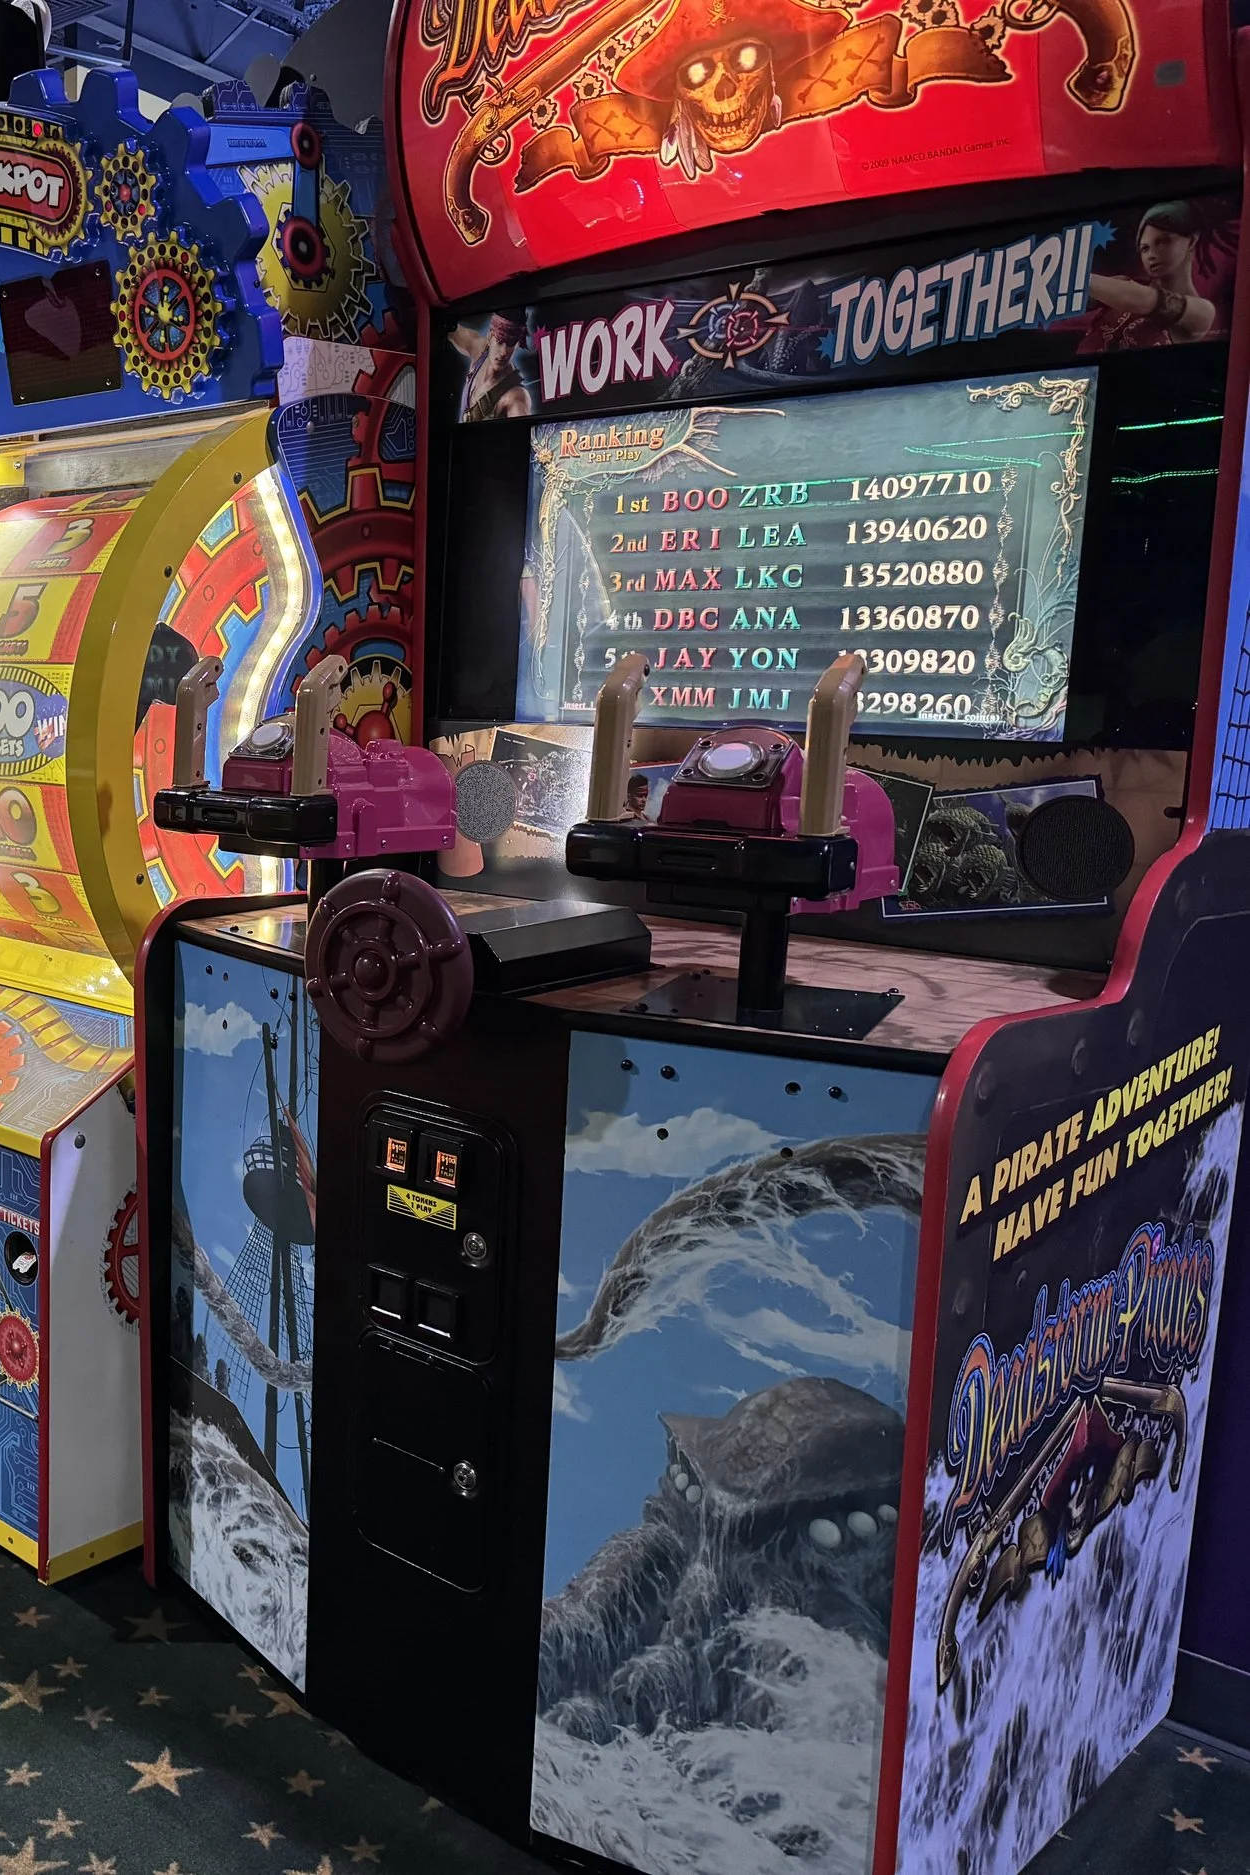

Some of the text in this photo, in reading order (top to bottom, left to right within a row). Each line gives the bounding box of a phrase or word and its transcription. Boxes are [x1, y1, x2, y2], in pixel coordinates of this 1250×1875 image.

[892, 152, 925, 165] NAMCO
[927, 147, 962, 159] BANDAI
[964, 140, 994, 152] Games
[539, 224, 1096, 401] WORK TOGETHER!!
[559, 424, 665, 459] Ranking
[588, 449, 642, 463] Pair Play
[615, 471, 992, 514] 1st BOO ZRB 14097710
[47, 518, 95, 555] 3
[610, 515, 988, 554] 2nd ERI LEA 13940620
[28, 557, 71, 569] TICKETS
[609, 560, 984, 593] 3rd MAX LKC 13520880
[606, 604, 980, 631] 4th DBC ANA 13360870
[654, 647, 717, 670] JAY
[728, 647, 800, 671] YON
[838, 648, 976, 675] 309820
[649, 686, 716, 709] XMM
[728, 688, 792, 712] JMJ
[918, 711, 948, 721] insert
[964, 712, 1000, 723] coin(s)
[11, 871, 63, 914] 3
[959, 1024, 1221, 1226] A PIRATE ADVENTURE!
[993, 1065, 1233, 1262] HAVE FUN TOGETHER!
[412, 1194, 437, 1208] TOKENS
[416, 1203, 432, 1214] PLAY
[2, 1208, 40, 1236] TICKETS
[946, 1222, 1214, 1540] Deadstorm Pirates
